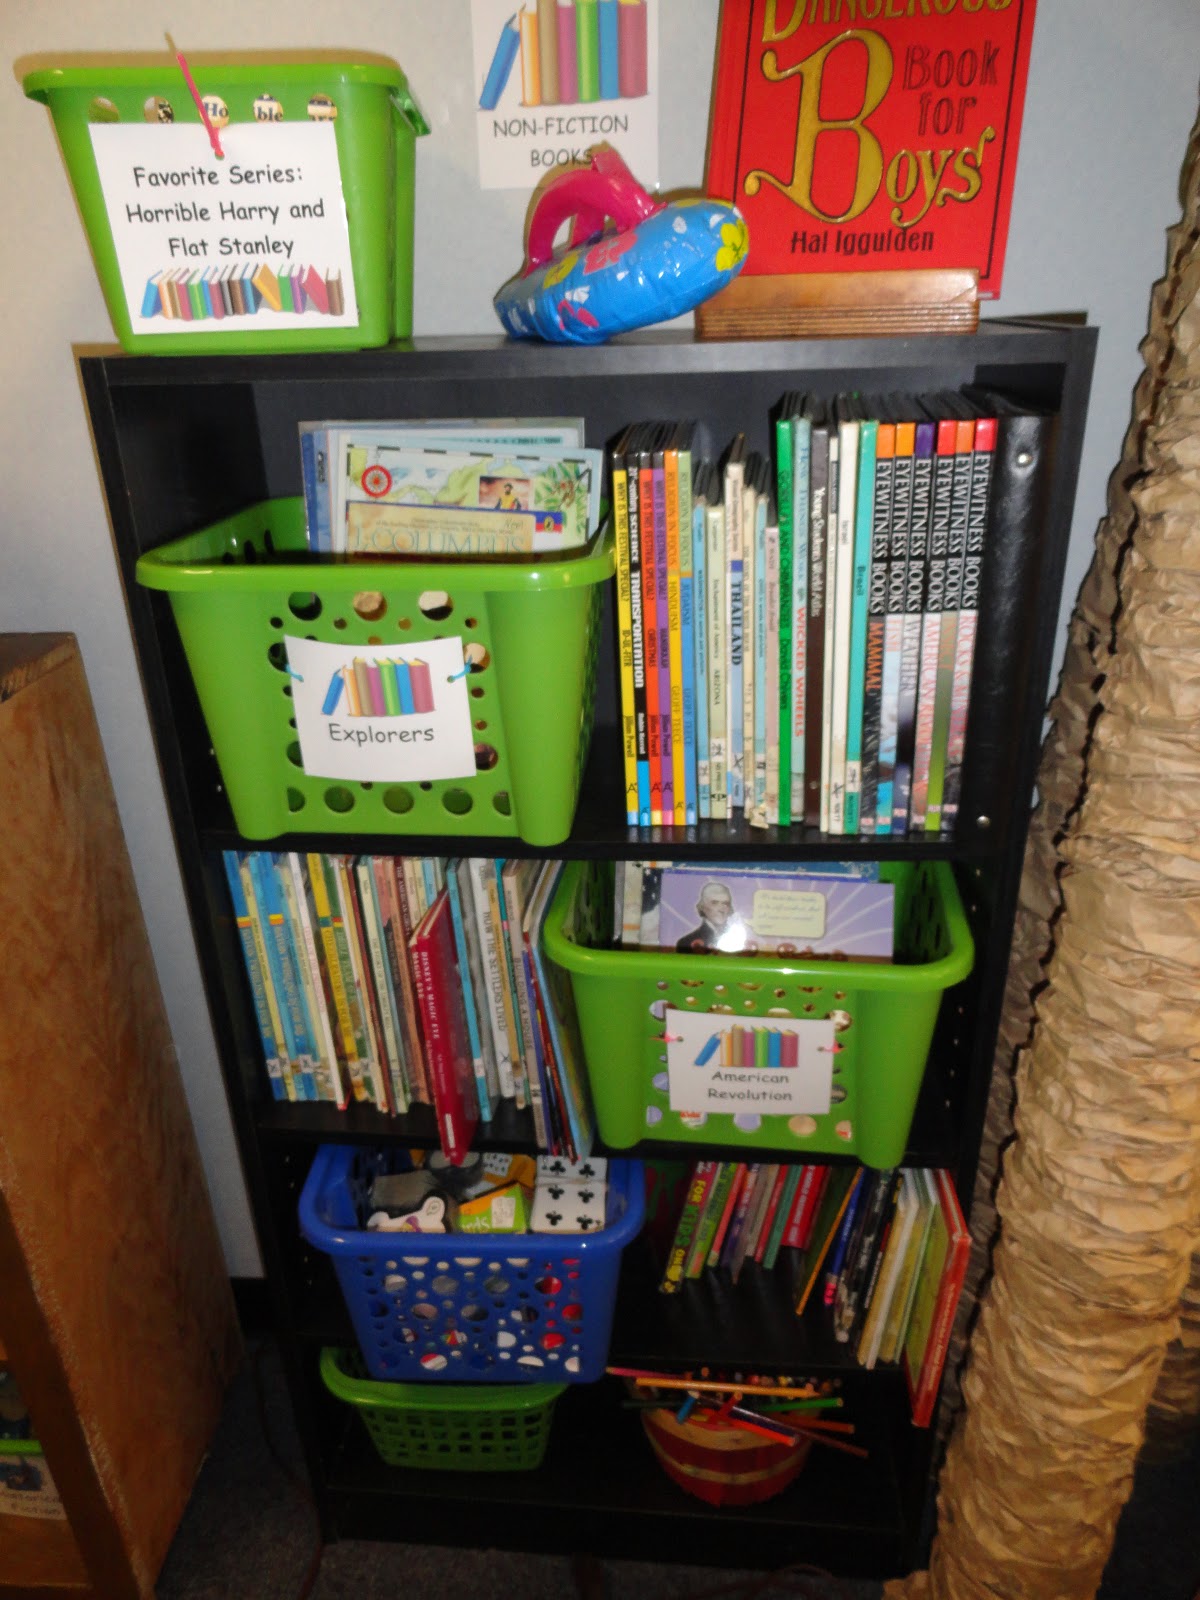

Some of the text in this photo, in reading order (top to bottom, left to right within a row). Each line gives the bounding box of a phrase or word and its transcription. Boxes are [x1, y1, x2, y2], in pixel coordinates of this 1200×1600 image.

[902, 41, 1000, 91] Book
[492, 115, 629, 137] NON-FICTION
[744, 28, 995, 228] Boys
[918, 90, 978, 136] for
[134, 164, 303, 188] Favorite Series:
[530, 148, 593, 167] BOOKS
[127, 200, 326, 226] Horrible Harry and
[168, 237, 295, 260] Flat Stanley
[791, 228, 934, 256] Hal Iggulden
[617, 482, 626, 501] WHY
[618, 512, 627, 529] THIS
[629, 513, 639, 563] SCIENCE
[870, 461, 892, 614] EYEWITNESS BOOKS
[888, 459, 911, 612] EYEWITNESS BOOKS
[906, 458, 932, 612] EYEWITNESS BOOKS
[926, 457, 953, 611] EYEWITNESS BOOKS
[944, 455, 971, 609] EYEWITNESS BOOKS
[962, 453, 990, 608] EYEWITNESS BOOKS
[619, 531, 628, 567] FESTIVAL
[644, 530, 654, 565] FESTIVAL
[656, 530, 666, 565] FESTIVAL
[620, 569, 629, 602] SPECIAL?
[669, 580, 678, 632] HINDUISM
[682, 582, 691, 626] JUDAISM
[631, 570, 644, 688] TRANSPORTATION
[731, 582, 742, 666] THAILAND
[796, 604, 806, 671] WICKED
[886, 618, 902, 652] FISH
[956, 615, 977, 666] ROCKS
[647, 628, 656, 668] CHRISTMAS
[866, 622, 884, 692] MAMMAL
[900, 618, 921, 693] WEATHER
[922, 619, 940, 699] AMERICAN
[795, 676, 806, 737] WHEELS
[328, 723, 435, 747] Explorers
[626, 735, 635, 758] Powell
[412, 951, 422, 979] MAGIC
[420, 951, 433, 992] DISNEY'S
[489, 958, 503, 1004] SETTLERS
[426, 994, 438, 1022] MAGIC
[431, 1023, 441, 1040] EYE
[707, 1088, 792, 1101] Revolution
[711, 1071, 789, 1084] American
